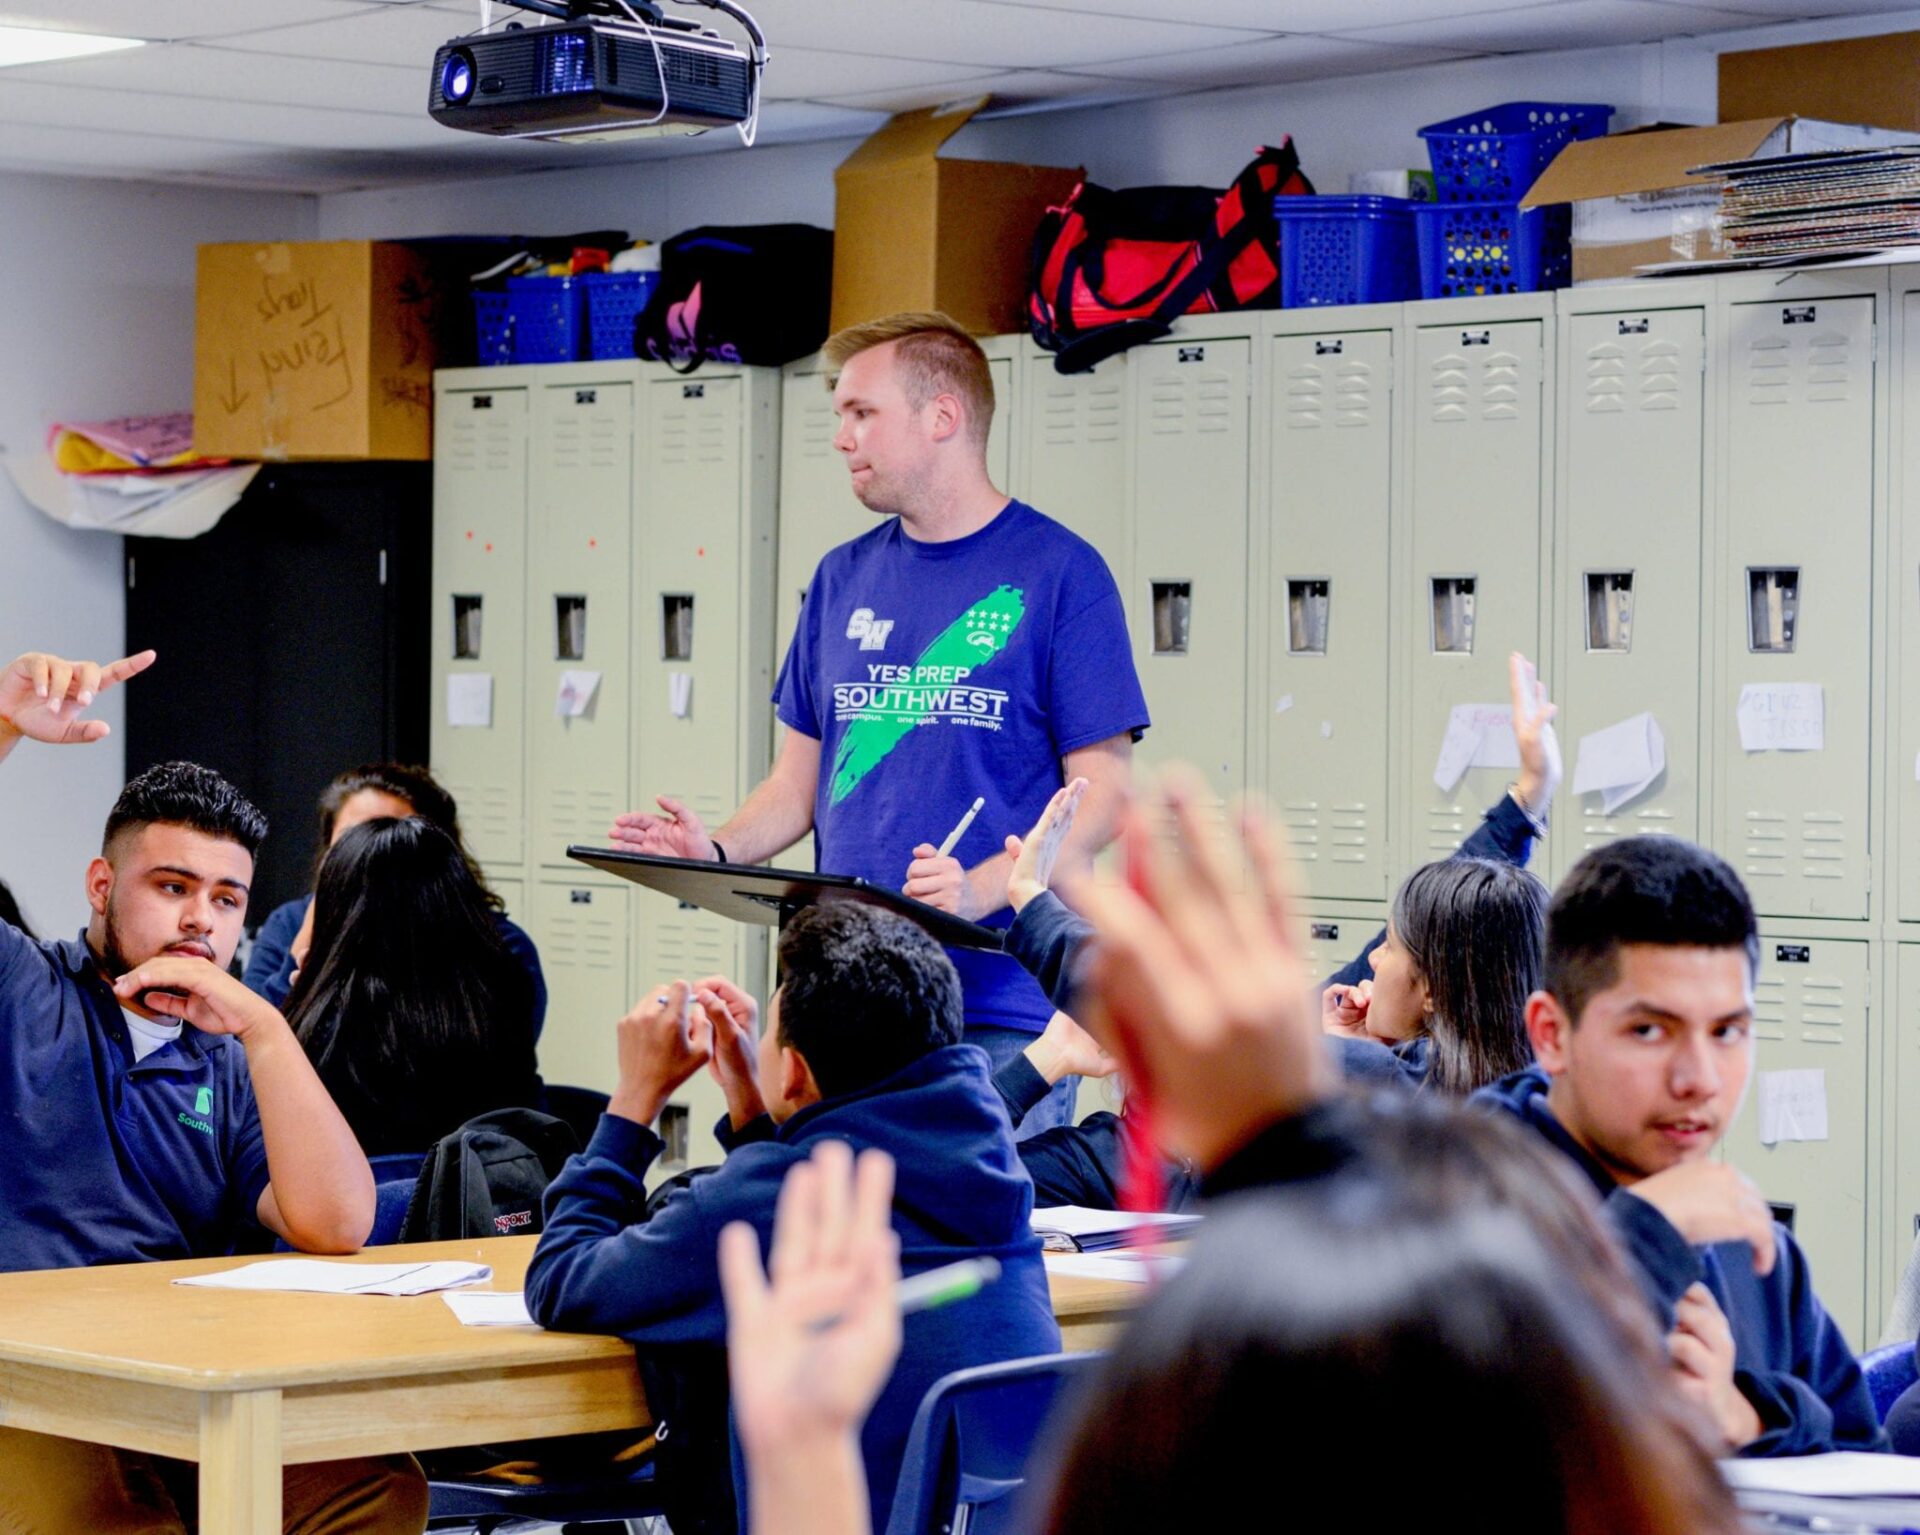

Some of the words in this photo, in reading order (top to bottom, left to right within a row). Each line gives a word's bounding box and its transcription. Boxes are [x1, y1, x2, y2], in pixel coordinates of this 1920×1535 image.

[846, 608, 894, 650] SW
[867, 664, 911, 683] YES
[915, 666, 970, 683] PREP
[834, 687, 1009, 716] SOUTHWEST
[897, 716, 914, 724] one
[951, 717, 968, 725] one
[970, 717, 1002, 731] family.
